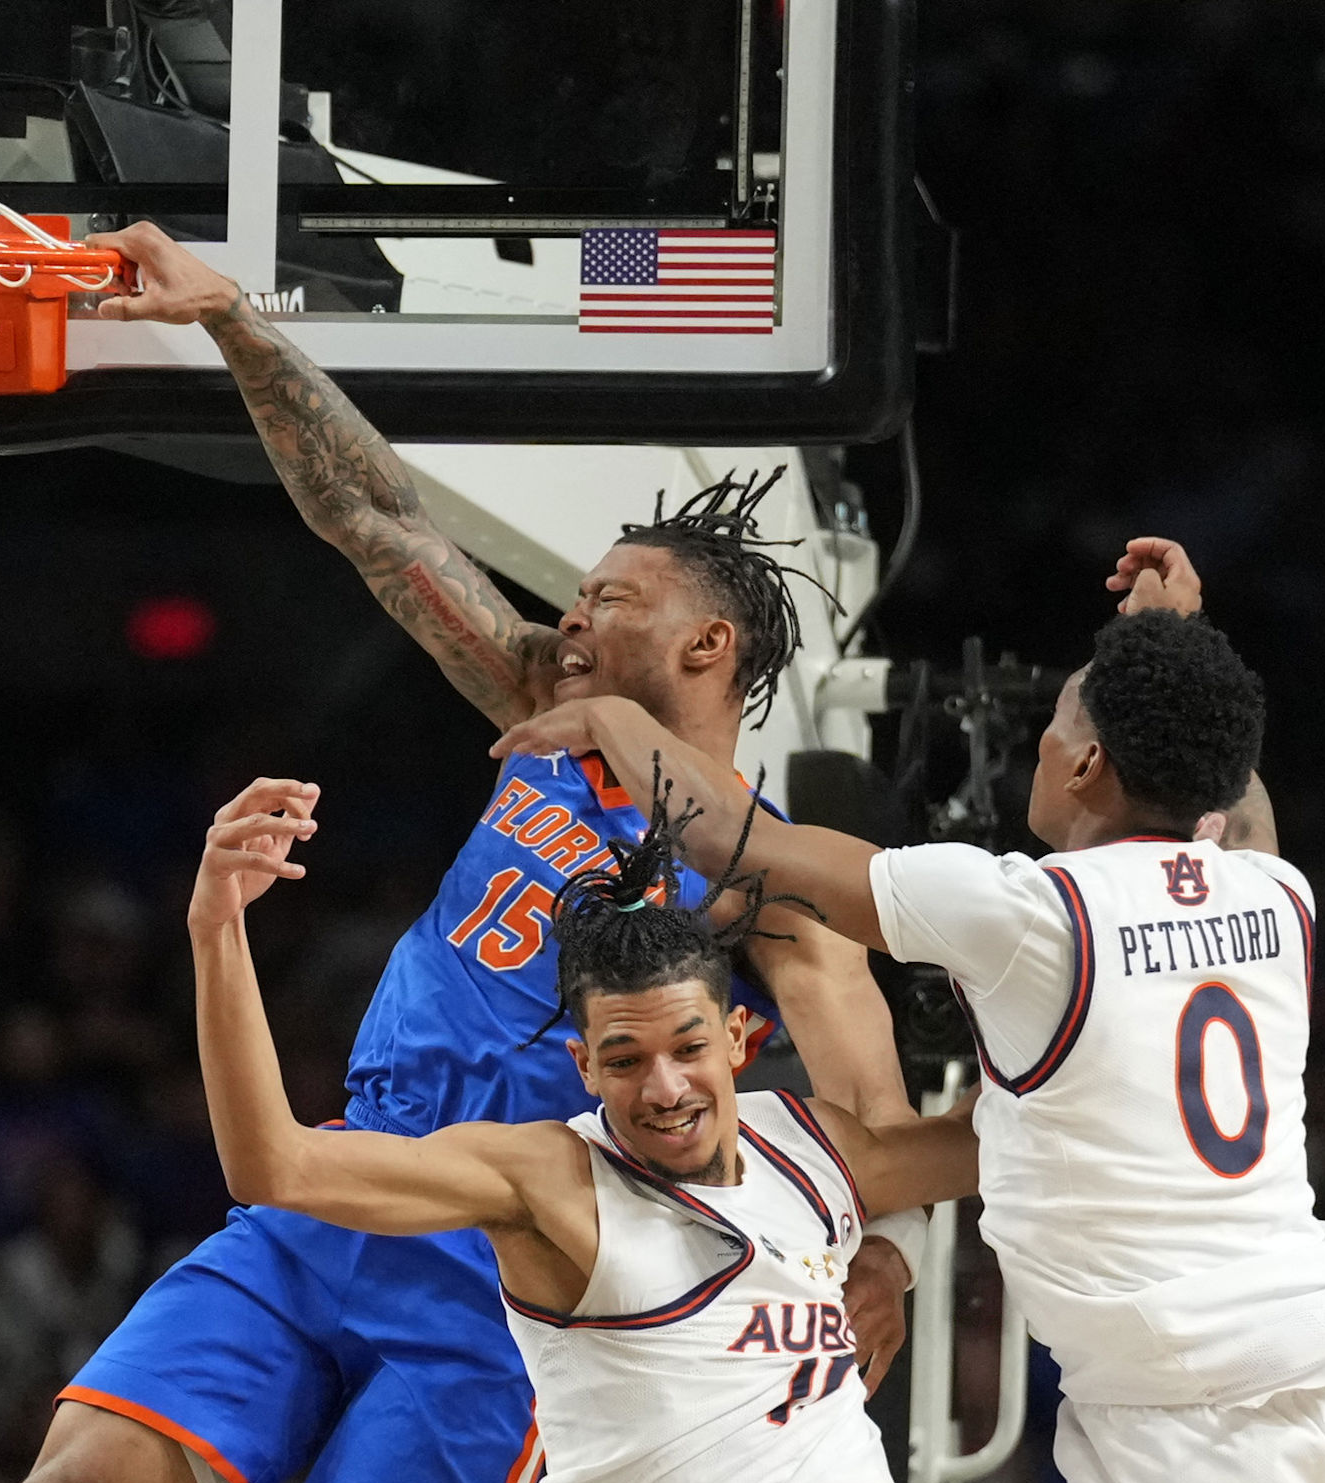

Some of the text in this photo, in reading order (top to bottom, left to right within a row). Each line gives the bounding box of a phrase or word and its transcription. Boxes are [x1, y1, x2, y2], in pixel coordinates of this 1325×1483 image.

[481, 776, 666, 907] FLORI
[447, 867, 563, 972] 15
[1118, 907, 1281, 977] PETTIFORD
[1175, 981, 1269, 1179] 0
